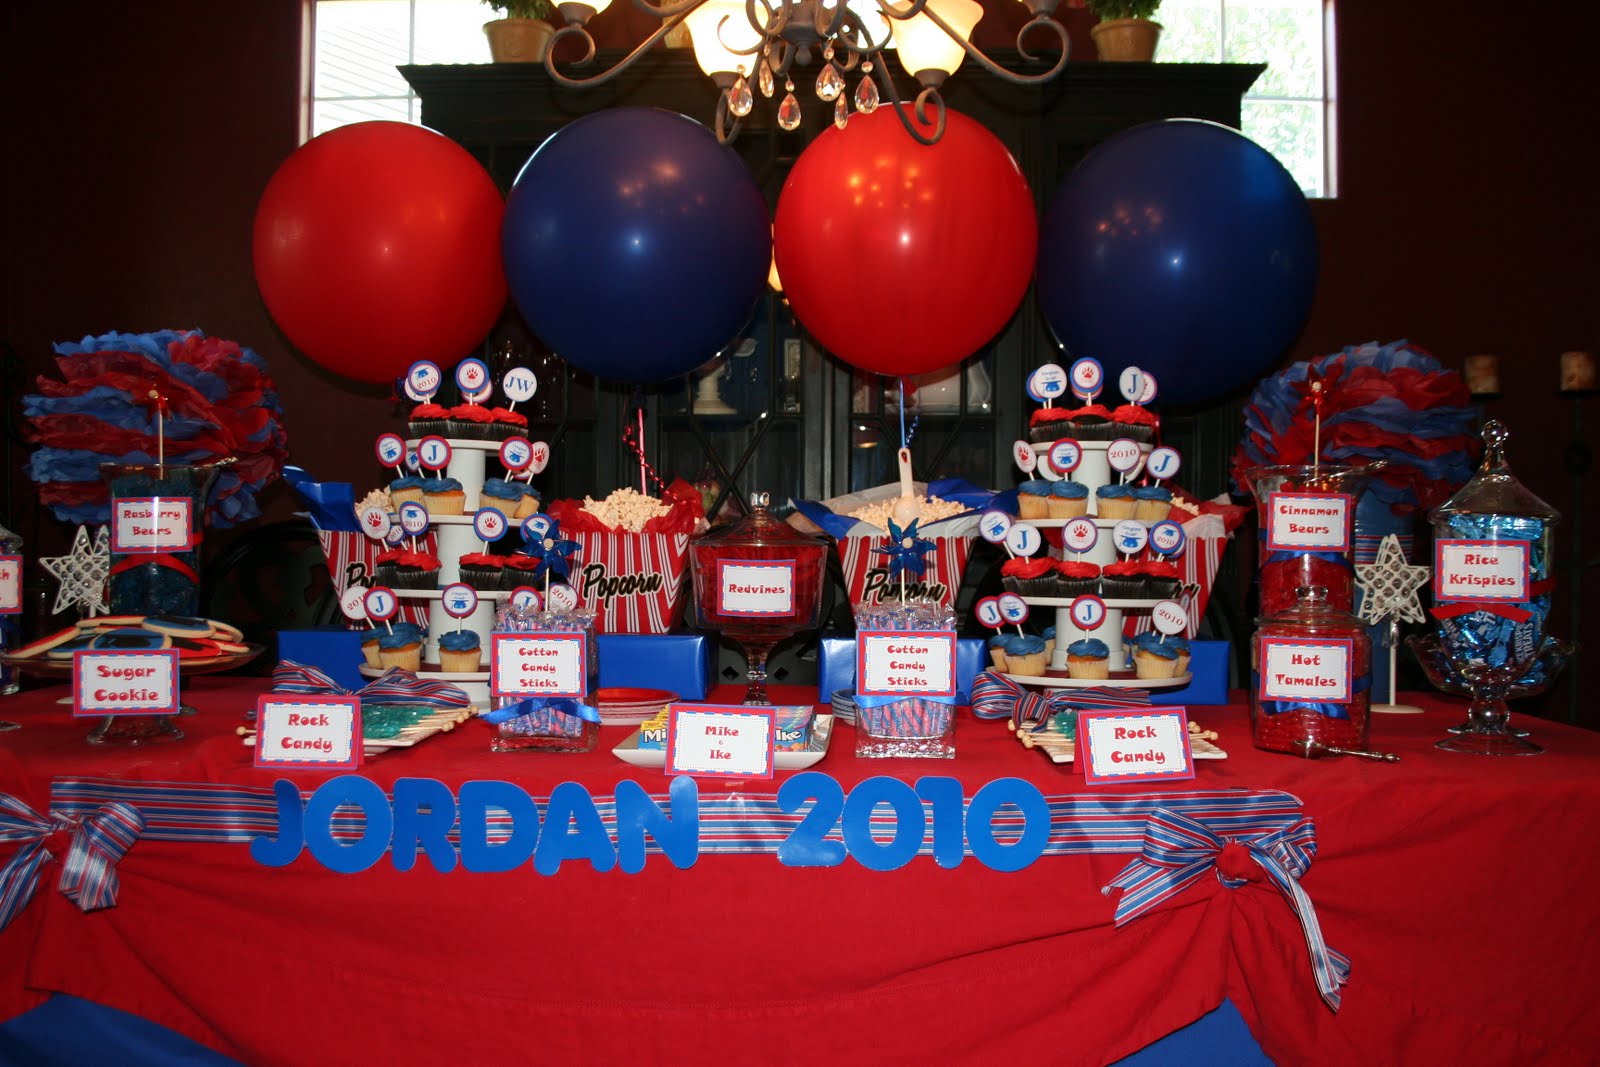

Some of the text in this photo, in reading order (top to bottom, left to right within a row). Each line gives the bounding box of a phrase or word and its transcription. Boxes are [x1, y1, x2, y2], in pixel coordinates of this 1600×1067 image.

[416, 377, 437, 390] 2010
[505, 376, 536, 393] JW
[1127, 373, 1138, 395] J
[427, 444, 438, 462] J
[1110, 448, 1137, 459] 2010
[1153, 454, 1173, 472] J
[123, 509, 182, 521] Rasbrry
[1279, 504, 1340, 516] Cinnamon
[131, 526, 173, 536] Bears
[1289, 523, 1329, 534] Bears
[1017, 530, 1029, 550] J
[1156, 536, 1175, 546] 2010
[1463, 553, 1498, 565] Rice
[582, 562, 664, 610] Popcorn
[1448, 573, 1516, 587] Krispies
[728, 583, 786, 594] Redvines
[346, 593, 365, 610] 201
[375, 595, 385, 613] J
[551, 587, 573, 608] 2010
[985, 604, 996, 621] J
[1082, 604, 1093, 621] J
[1158, 608, 1184, 626] 2010
[518, 647, 559, 657] Cotton
[886, 645, 929, 654] Cotton
[889, 661, 926, 672] Candy
[1291, 654, 1320, 666] Hot
[97, 665, 156, 681] Sugar
[521, 663, 557, 673] Candy
[519, 678, 559, 688] Sticks
[887, 676, 928, 686] Sticks
[1275, 673, 1337, 687] Tamales
[94, 689, 159, 702] Cookie
[288, 713, 328, 726] Rock
[644, 729, 667, 743] Mi
[705, 725, 739, 737] Mike
[775, 730, 802, 741] Ike
[1114, 725, 1156, 739] Rock
[280, 736, 333, 752] Candy
[709, 749, 732, 760] Ike
[1110, 750, 1166, 764] Candy
[251, 773, 1052, 875] JORDAN 2010
